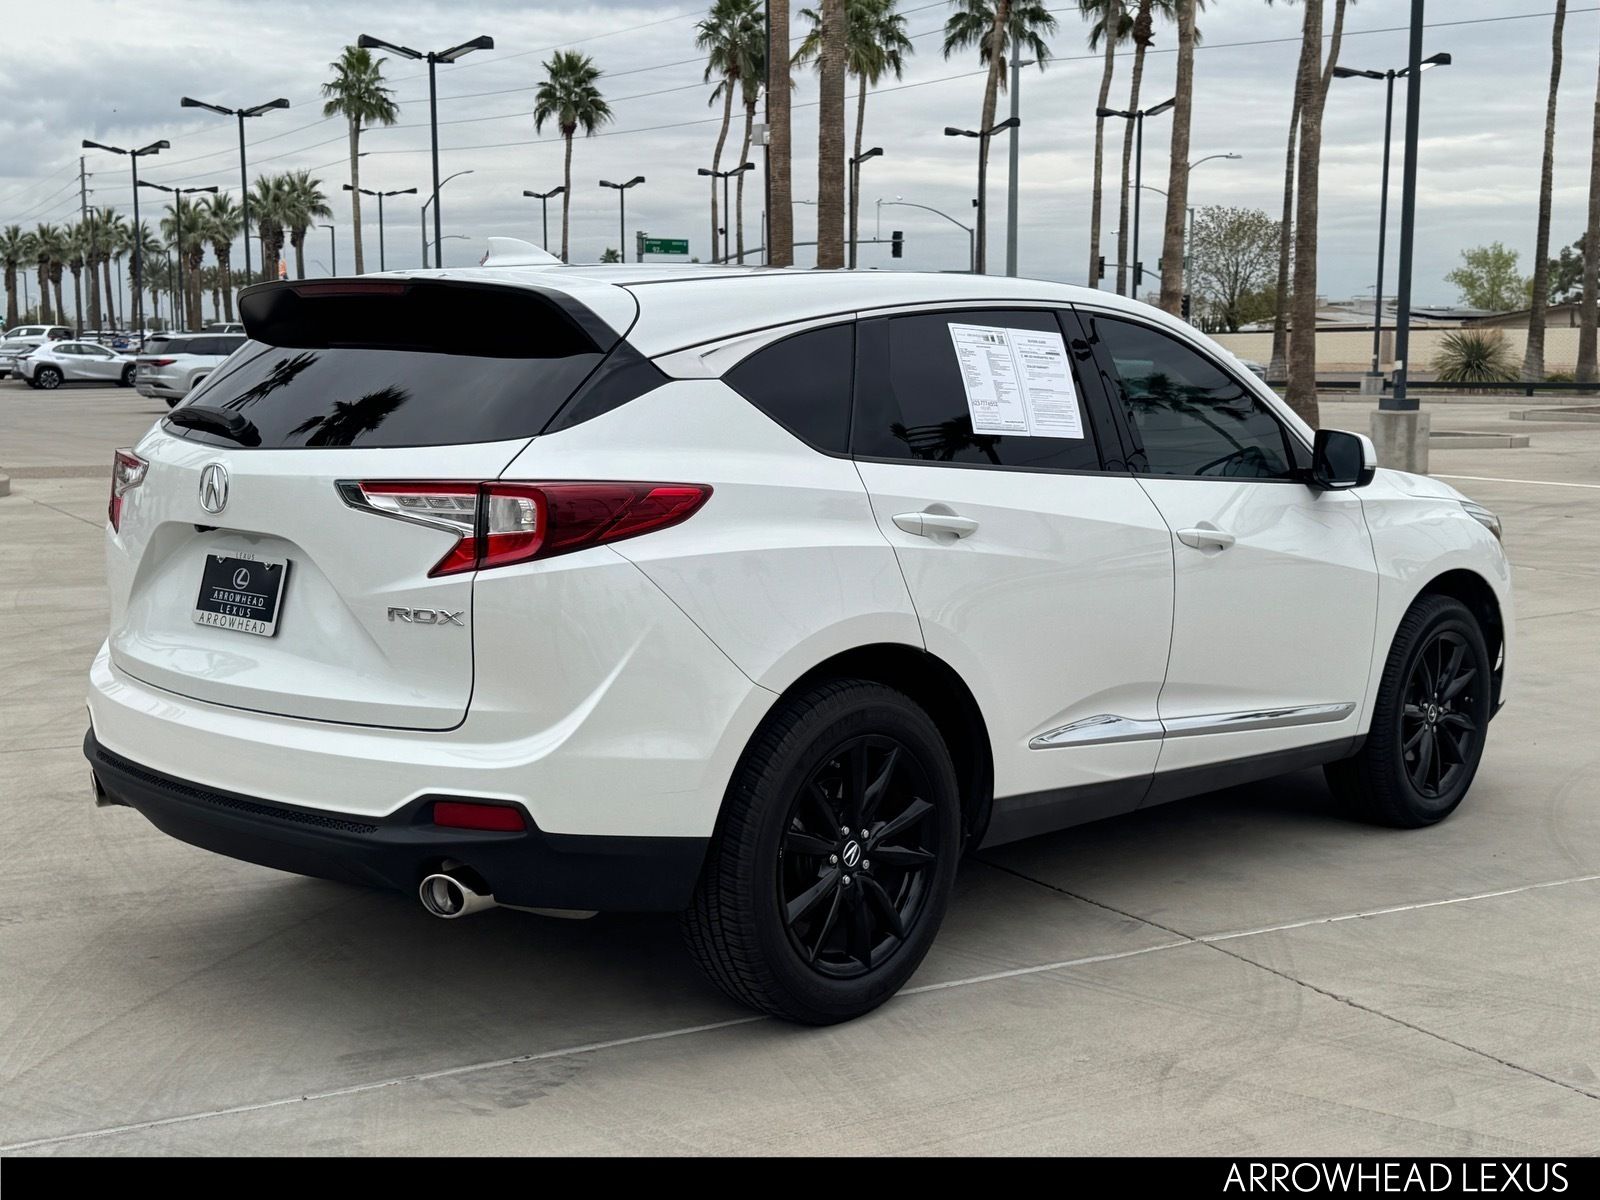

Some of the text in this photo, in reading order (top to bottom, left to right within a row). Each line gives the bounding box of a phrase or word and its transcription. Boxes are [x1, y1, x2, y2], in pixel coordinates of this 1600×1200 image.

[236, 552, 255, 560] LEXUS
[213, 590, 264, 607] ARROWHEAD
[220, 603, 251, 618] LEXUS
[387, 606, 464, 626] RDX
[198, 612, 266, 633] ARROWHEAD
